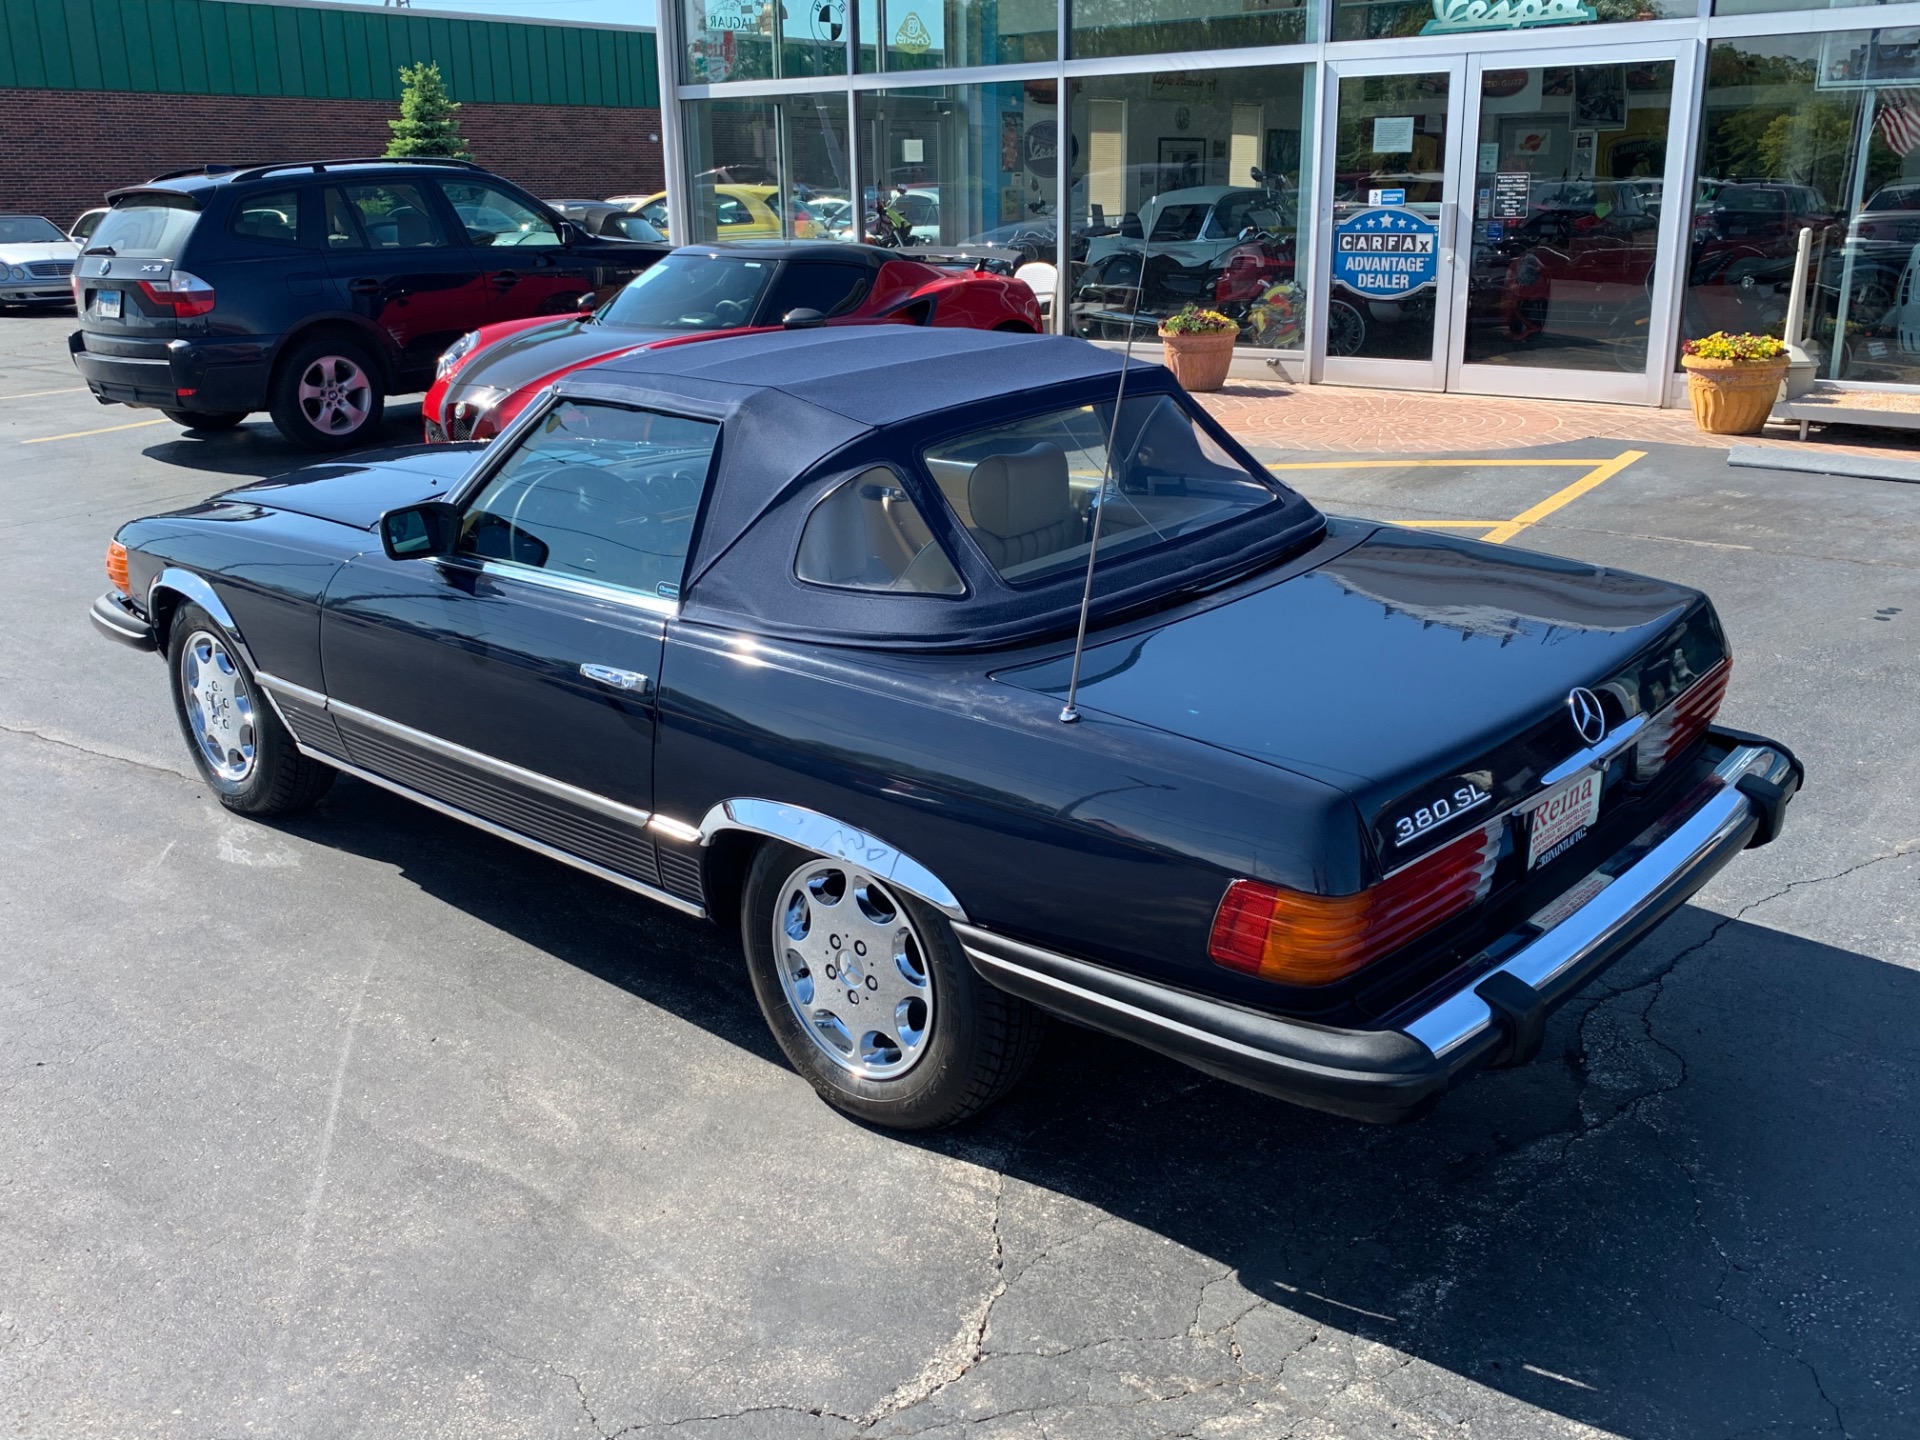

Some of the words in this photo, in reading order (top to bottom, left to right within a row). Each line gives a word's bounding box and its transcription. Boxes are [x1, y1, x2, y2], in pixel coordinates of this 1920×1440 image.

[1431, 0, 1589, 29] Vespa
[1341, 236, 1430, 253] CARFAX
[140, 264, 164, 273] X3
[1345, 256, 1424, 272] ADVANTAGE
[1357, 273, 1410, 289] DEALER
[1395, 798, 1451, 840] 380
[1453, 783, 1485, 809] SL
[1533, 777, 1593, 834] Reina
